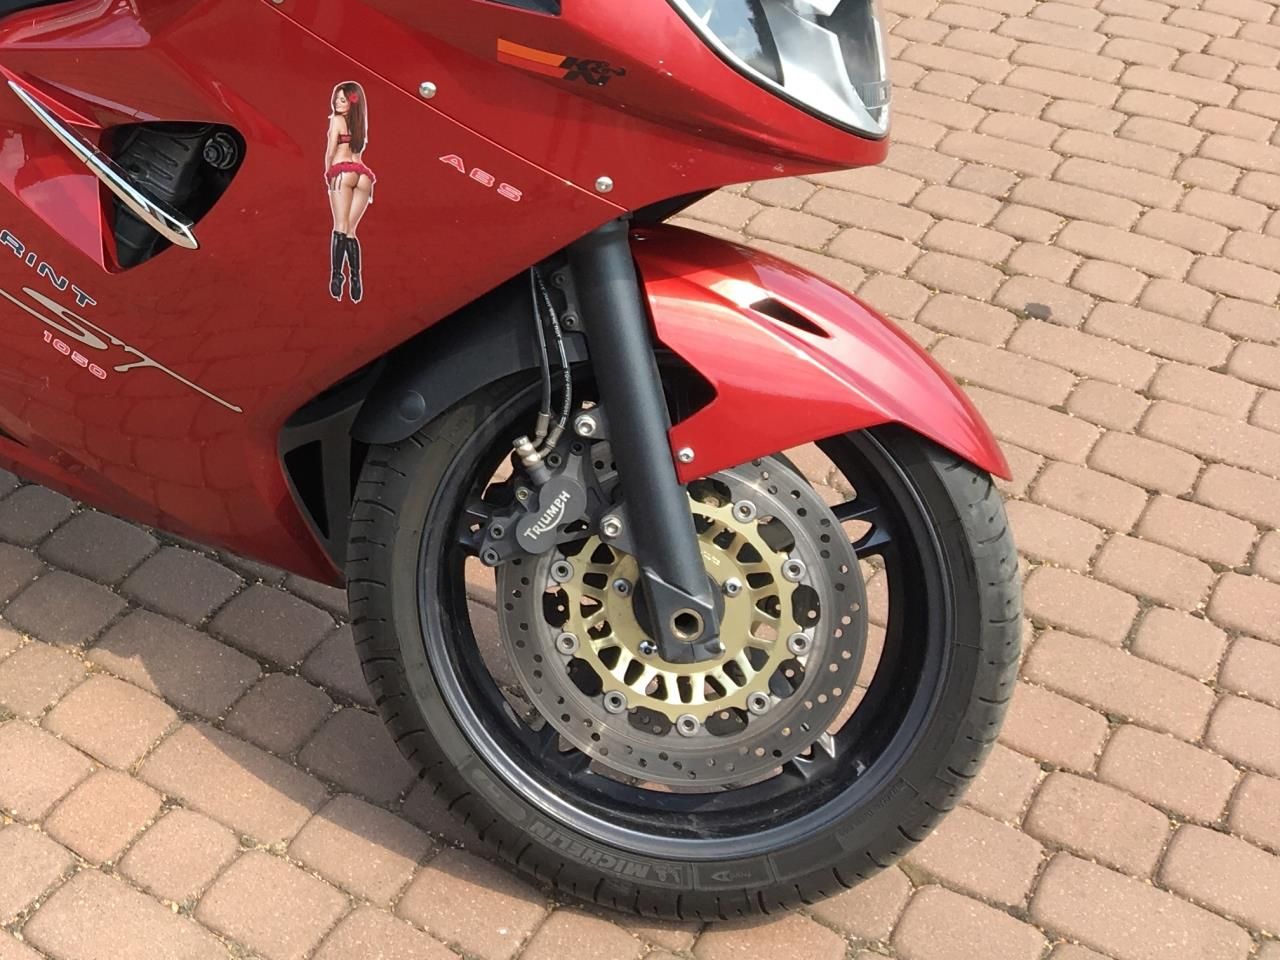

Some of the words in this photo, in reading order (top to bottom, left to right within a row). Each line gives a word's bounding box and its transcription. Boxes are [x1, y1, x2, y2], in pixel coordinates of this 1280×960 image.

[438, 153, 523, 202] ABS
[42, 329, 107, 381] 1050
[523, 490, 570, 540] TRIUMPH
[528, 820, 650, 878] MICHELIN
